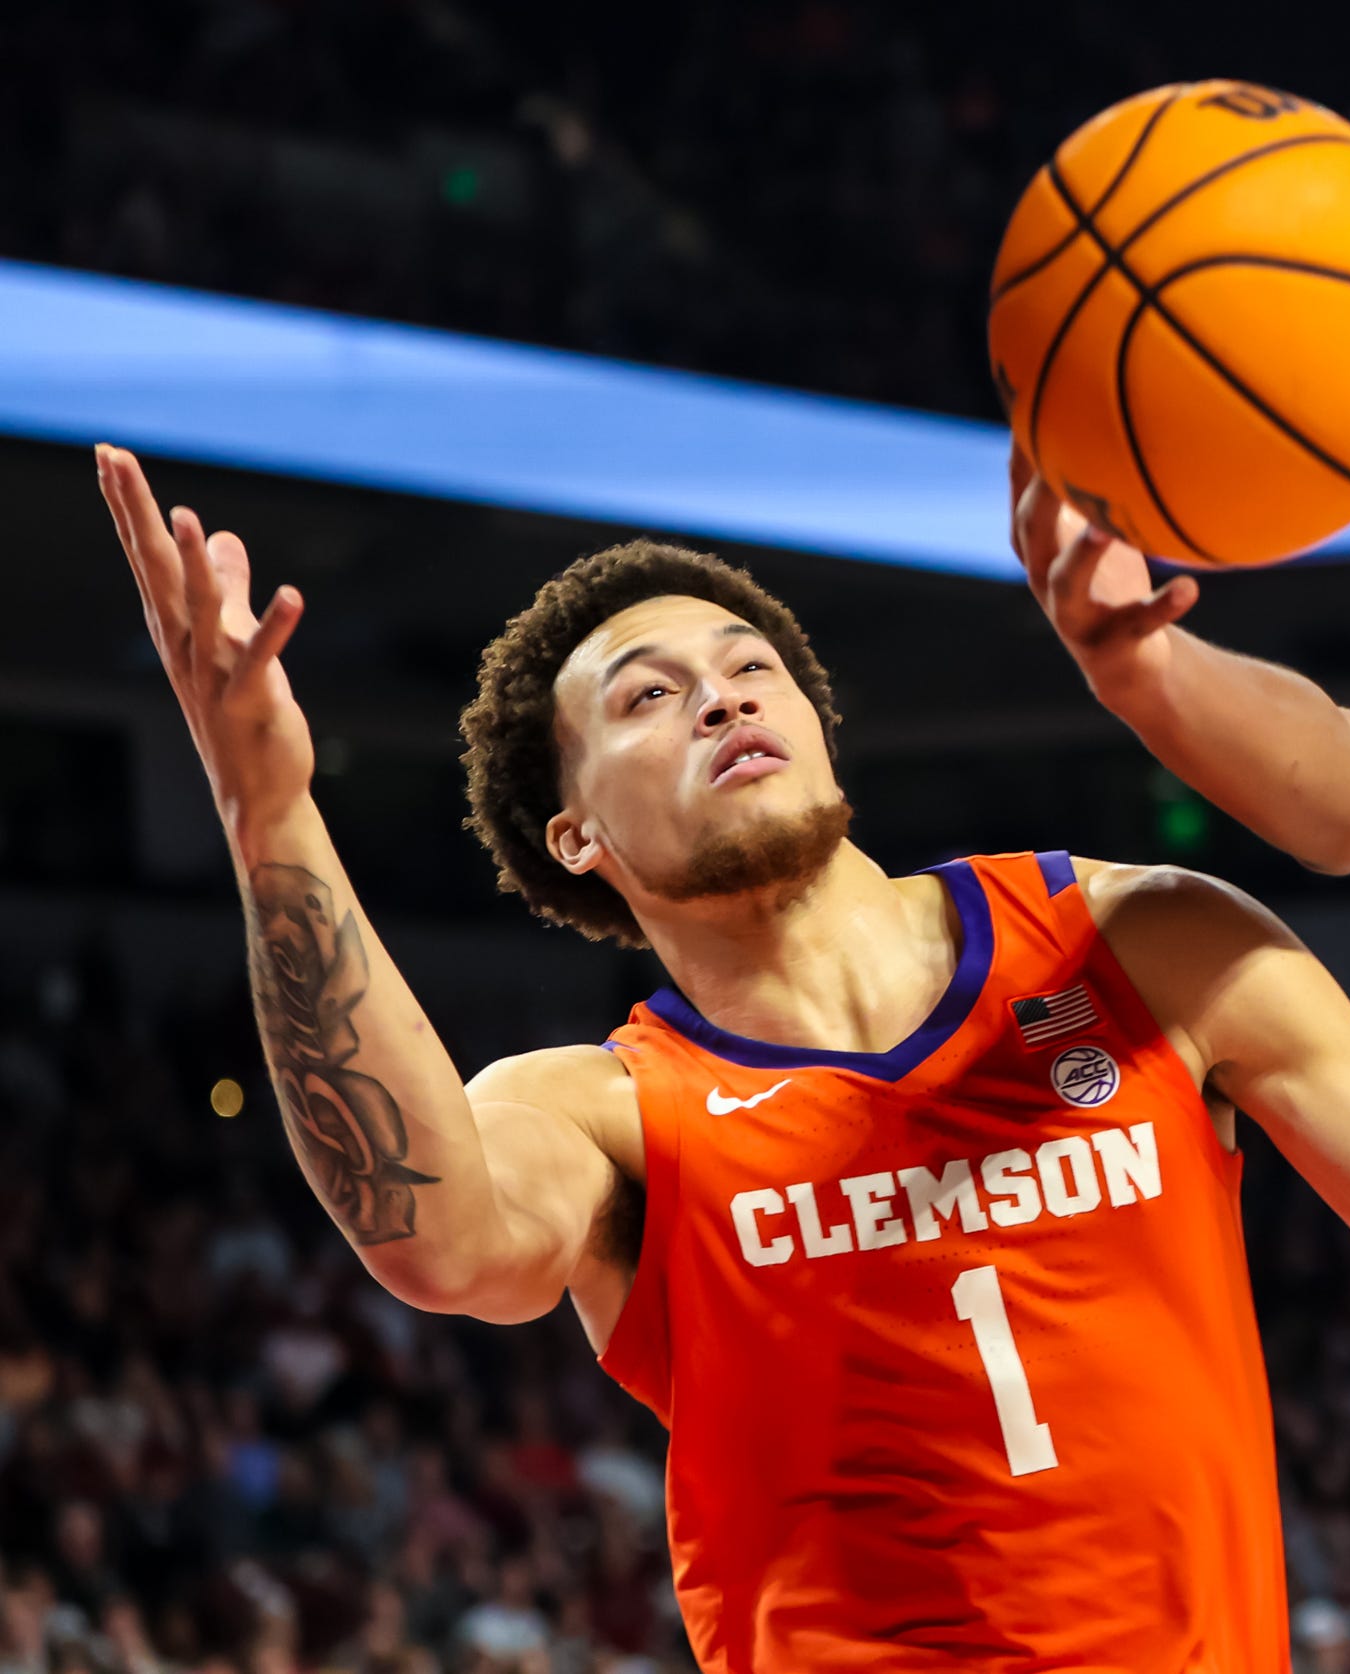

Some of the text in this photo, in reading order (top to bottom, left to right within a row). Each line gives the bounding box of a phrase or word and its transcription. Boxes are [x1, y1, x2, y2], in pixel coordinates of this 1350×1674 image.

[1063, 1058, 1107, 1084] ACC
[730, 1122, 1163, 1267] CLEMSON
[951, 1265, 1058, 1477] 1
